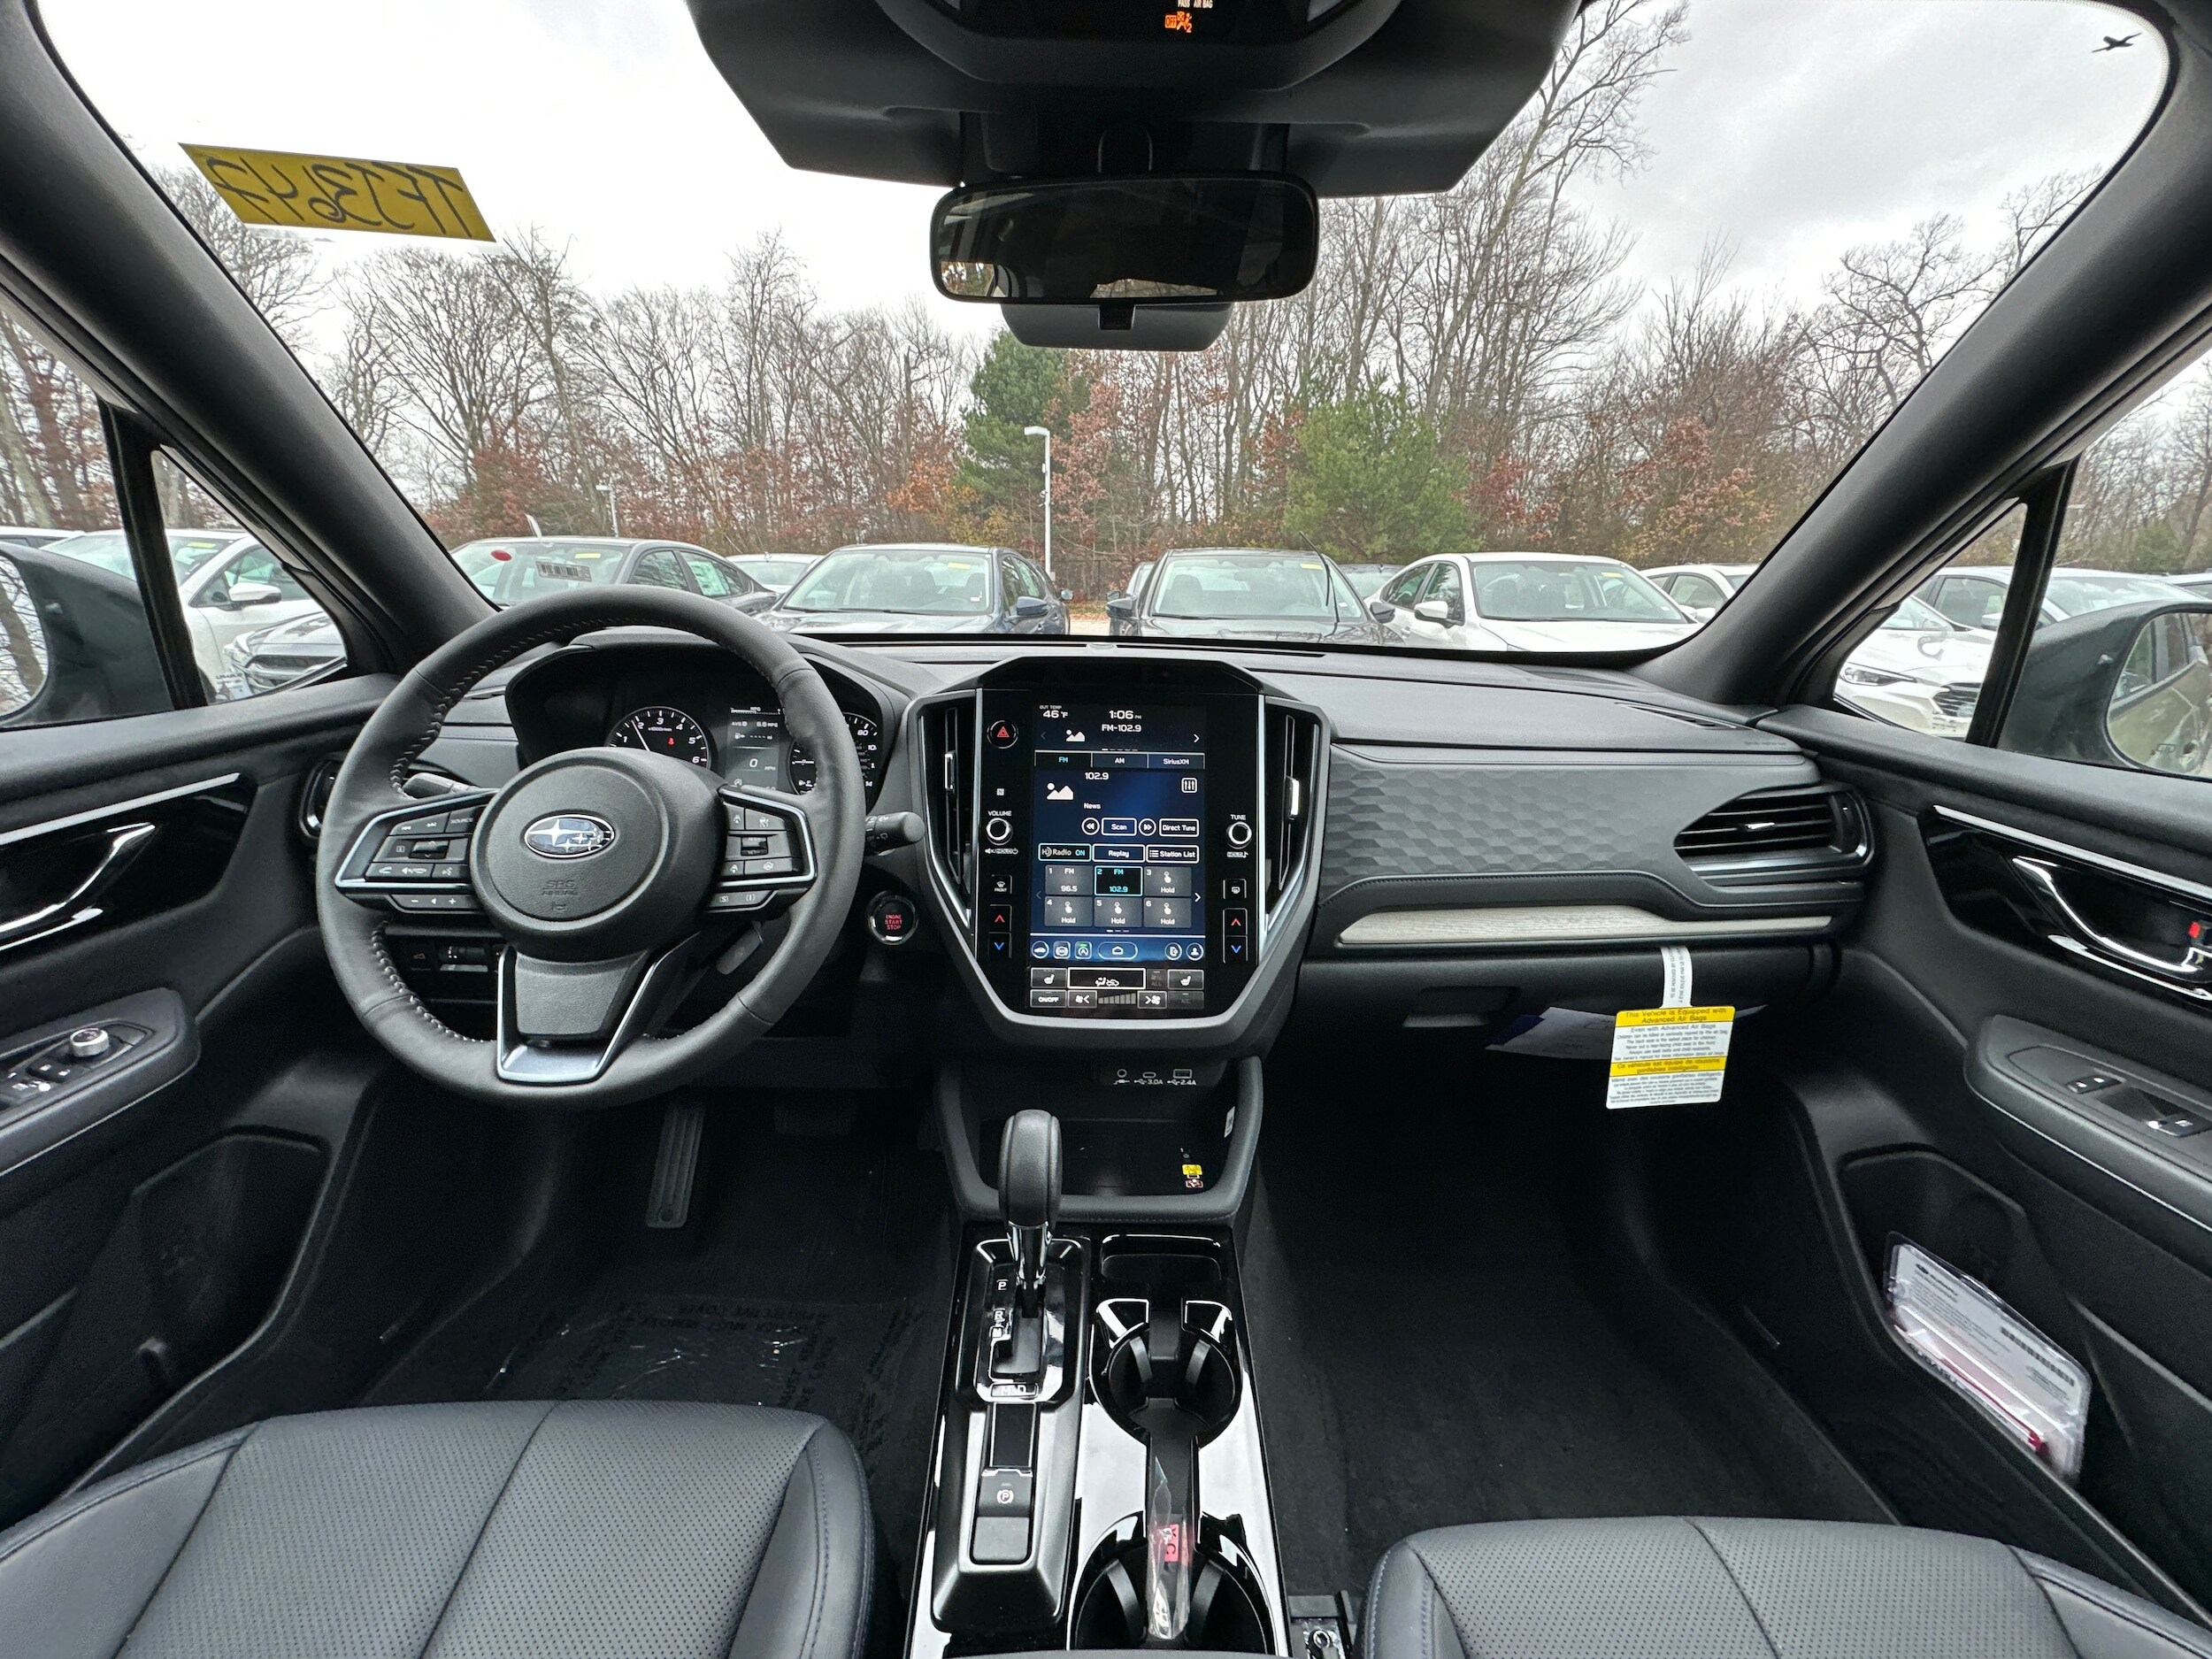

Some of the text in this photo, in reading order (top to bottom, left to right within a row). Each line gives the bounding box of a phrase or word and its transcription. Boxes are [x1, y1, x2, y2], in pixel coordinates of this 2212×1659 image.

[1109, 710, 1134, 719] 1:06
[1101, 724, 1141, 732] FM-102.9
[749, 758, 758, 767] 0
[1085, 772, 1109, 780] 102.9
[1108, 850, 1129, 858] Replay
[998, 1281, 1007, 1290] P
[995, 1310, 1004, 1320] R
